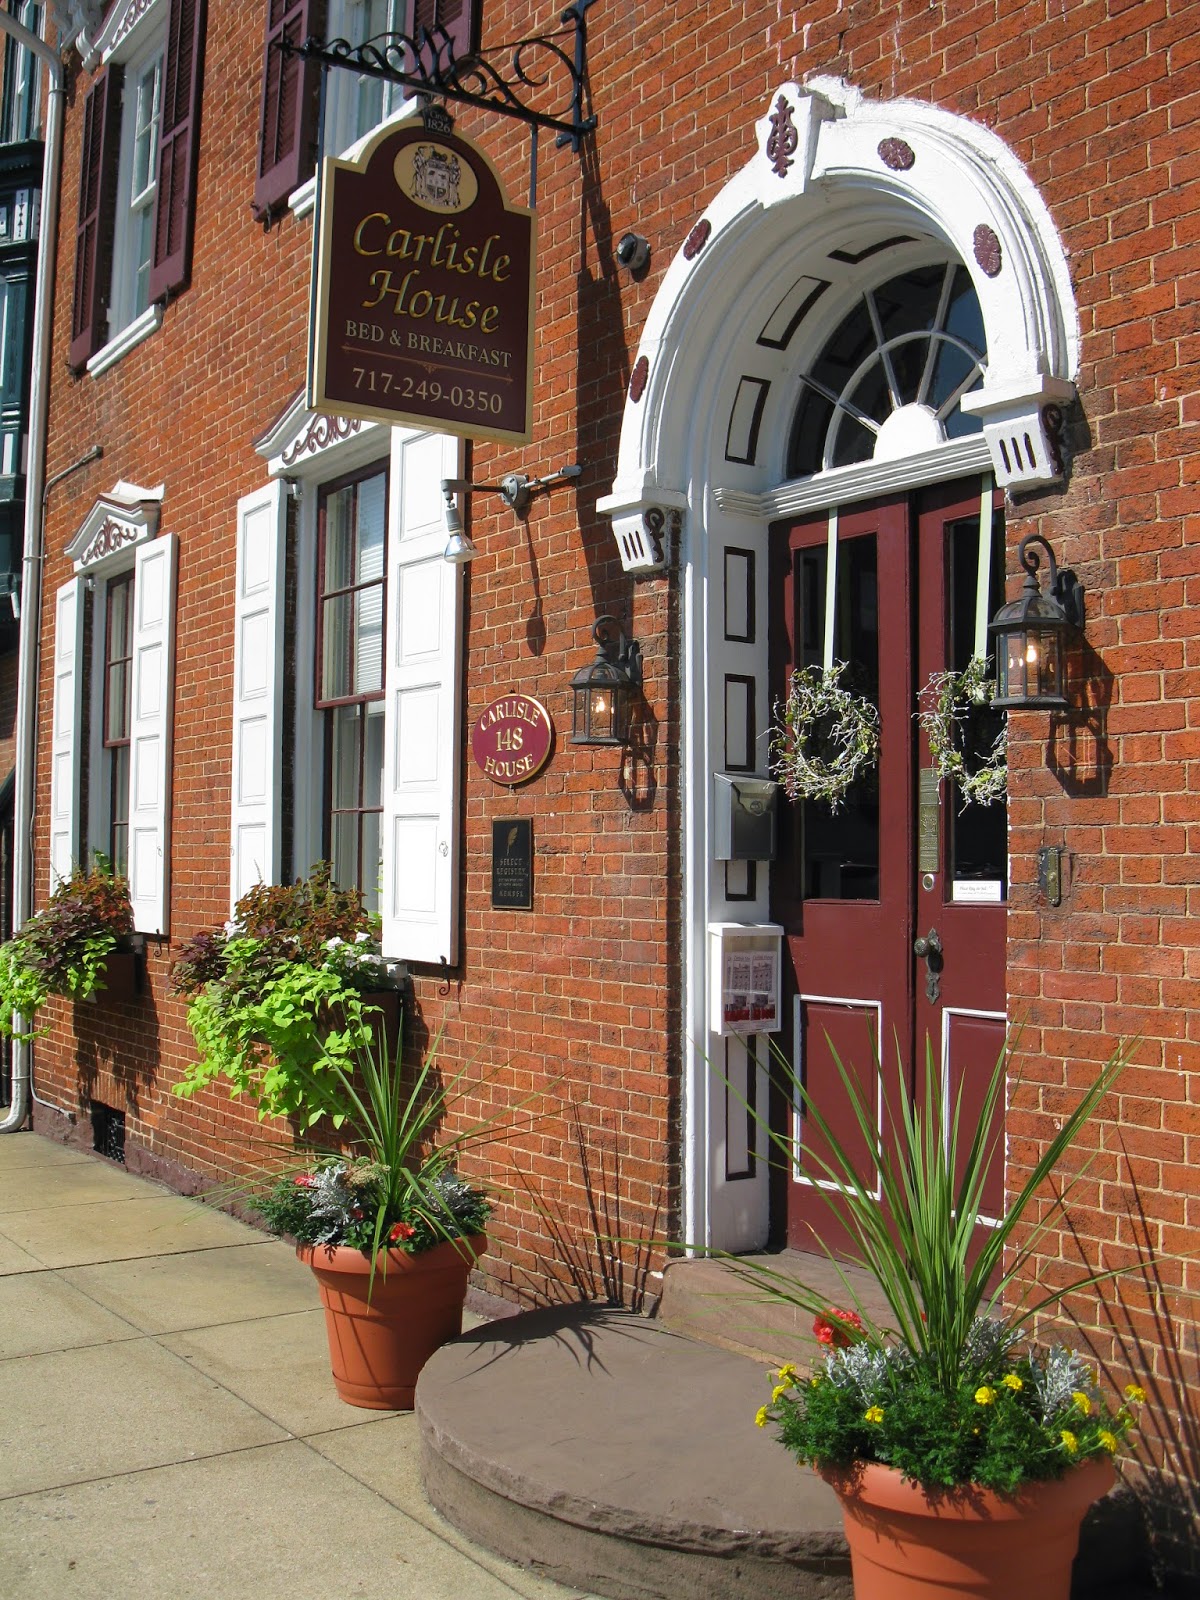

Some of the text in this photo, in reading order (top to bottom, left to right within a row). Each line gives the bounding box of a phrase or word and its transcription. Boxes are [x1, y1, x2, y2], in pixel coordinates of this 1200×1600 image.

[427, 118, 450, 133] 1826
[353, 212, 511, 282] Carlisle
[361, 269, 500, 334] House
[345, 320, 512, 368] BED & BREAKFAST
[352, 367, 503, 414] 717-249-0350
[480, 700, 541, 731] CARLISLE
[496, 727, 524, 752] 148
[484, 753, 535, 777] HOUSE
